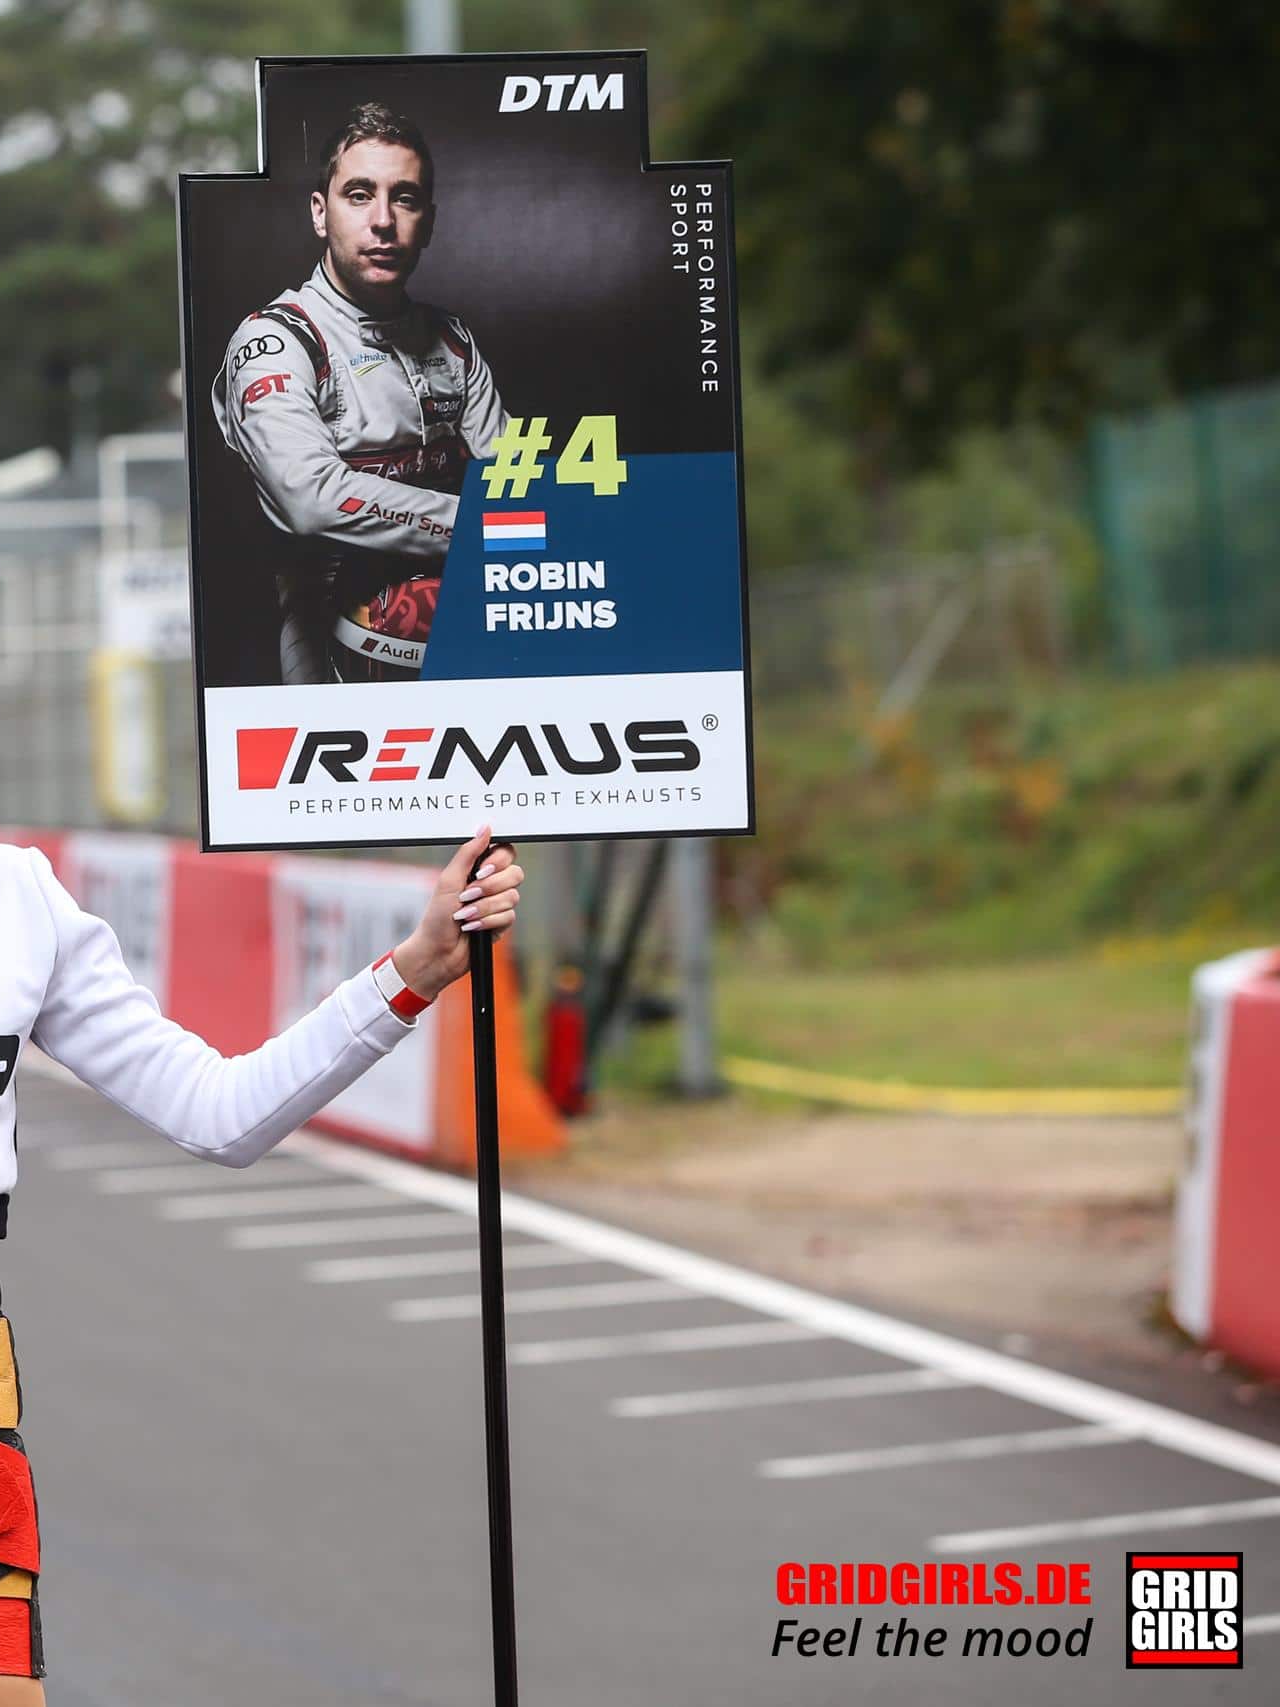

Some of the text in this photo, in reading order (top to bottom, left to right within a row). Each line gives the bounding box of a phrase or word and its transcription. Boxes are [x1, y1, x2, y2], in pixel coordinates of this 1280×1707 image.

[499, 74, 624, 112] DTM
[670, 184, 689, 273] SPORT
[696, 184, 719, 392] PERFORMANCE
[481, 415, 628, 499] #4
[366, 503, 415, 526] Audi
[484, 561, 605, 592] ROBIN
[486, 600, 618, 631] FRIJNS
[380, 643, 419, 660] Audi
[290, 787, 701, 814] PERFORMANCE SPORT EXHAUSTS
